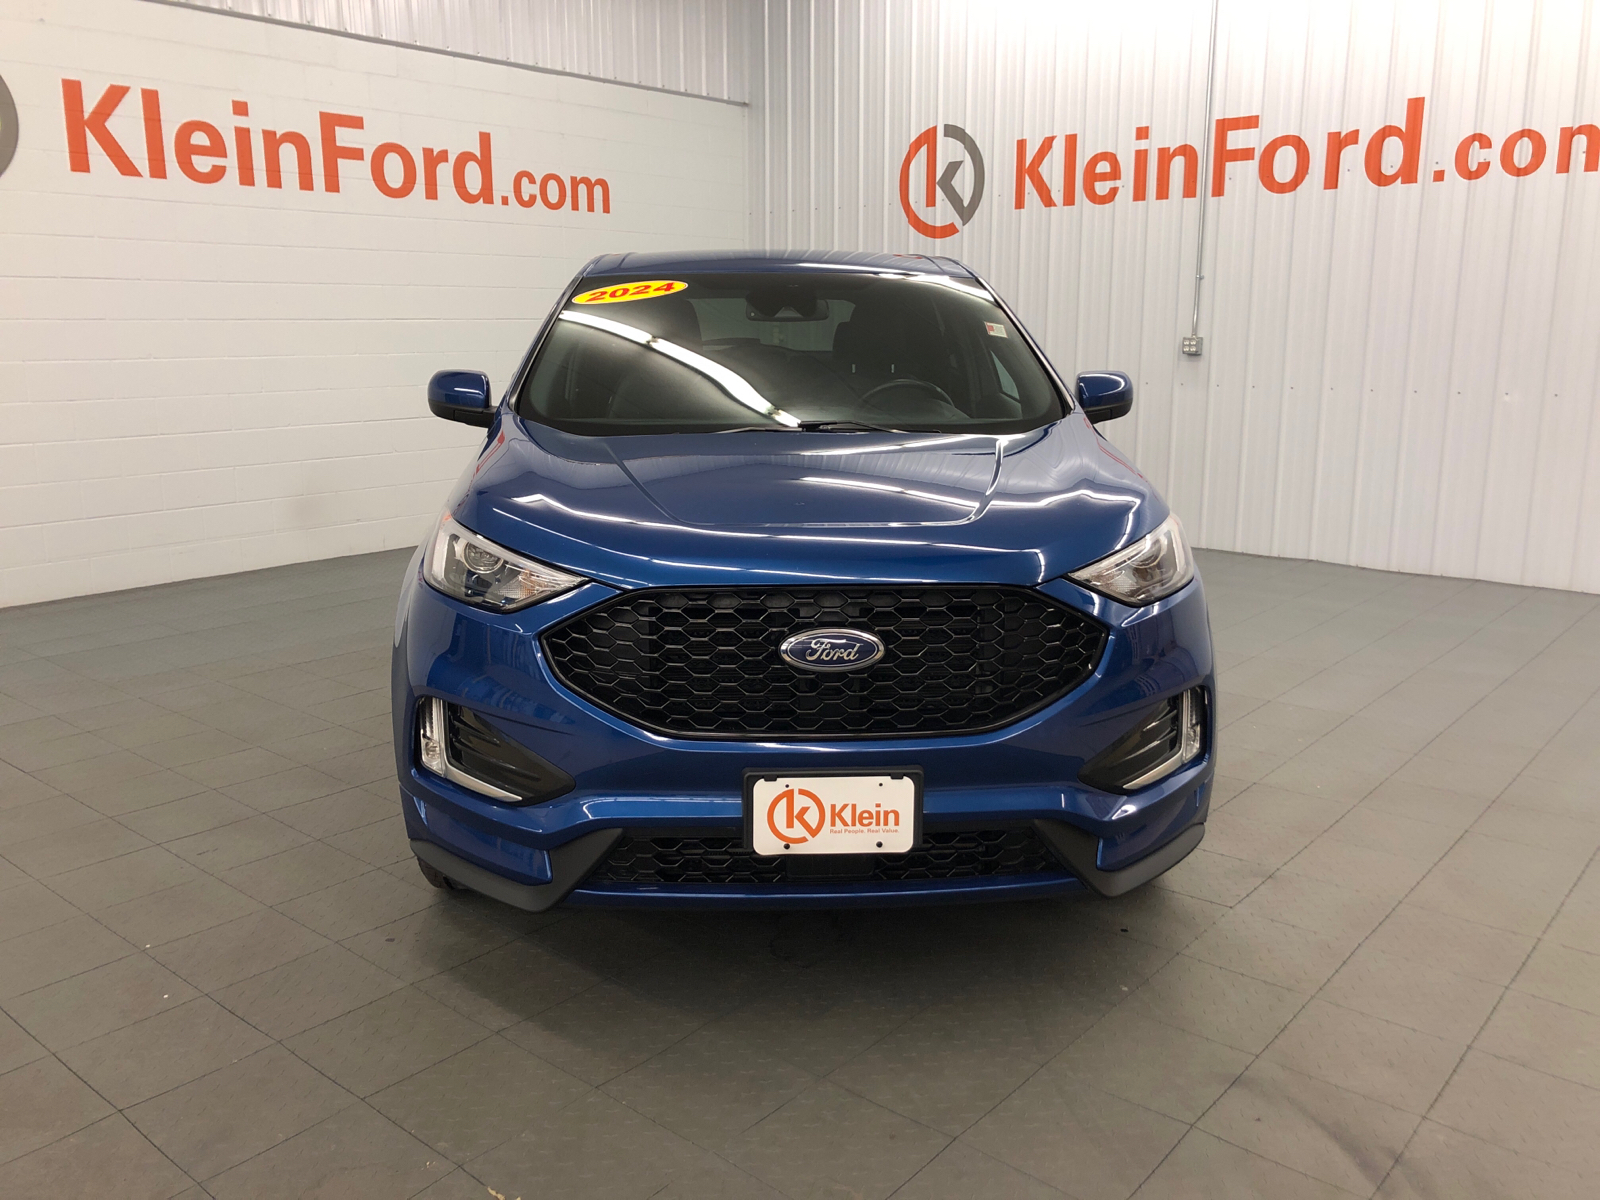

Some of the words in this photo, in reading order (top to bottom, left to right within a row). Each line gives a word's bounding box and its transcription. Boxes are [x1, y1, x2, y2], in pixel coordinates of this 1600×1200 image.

[61, 78, 612, 215] KleinFord.com
[585, 282, 676, 303] 2024
[805, 638, 864, 661] Ford
[830, 803, 900, 827] Klein
